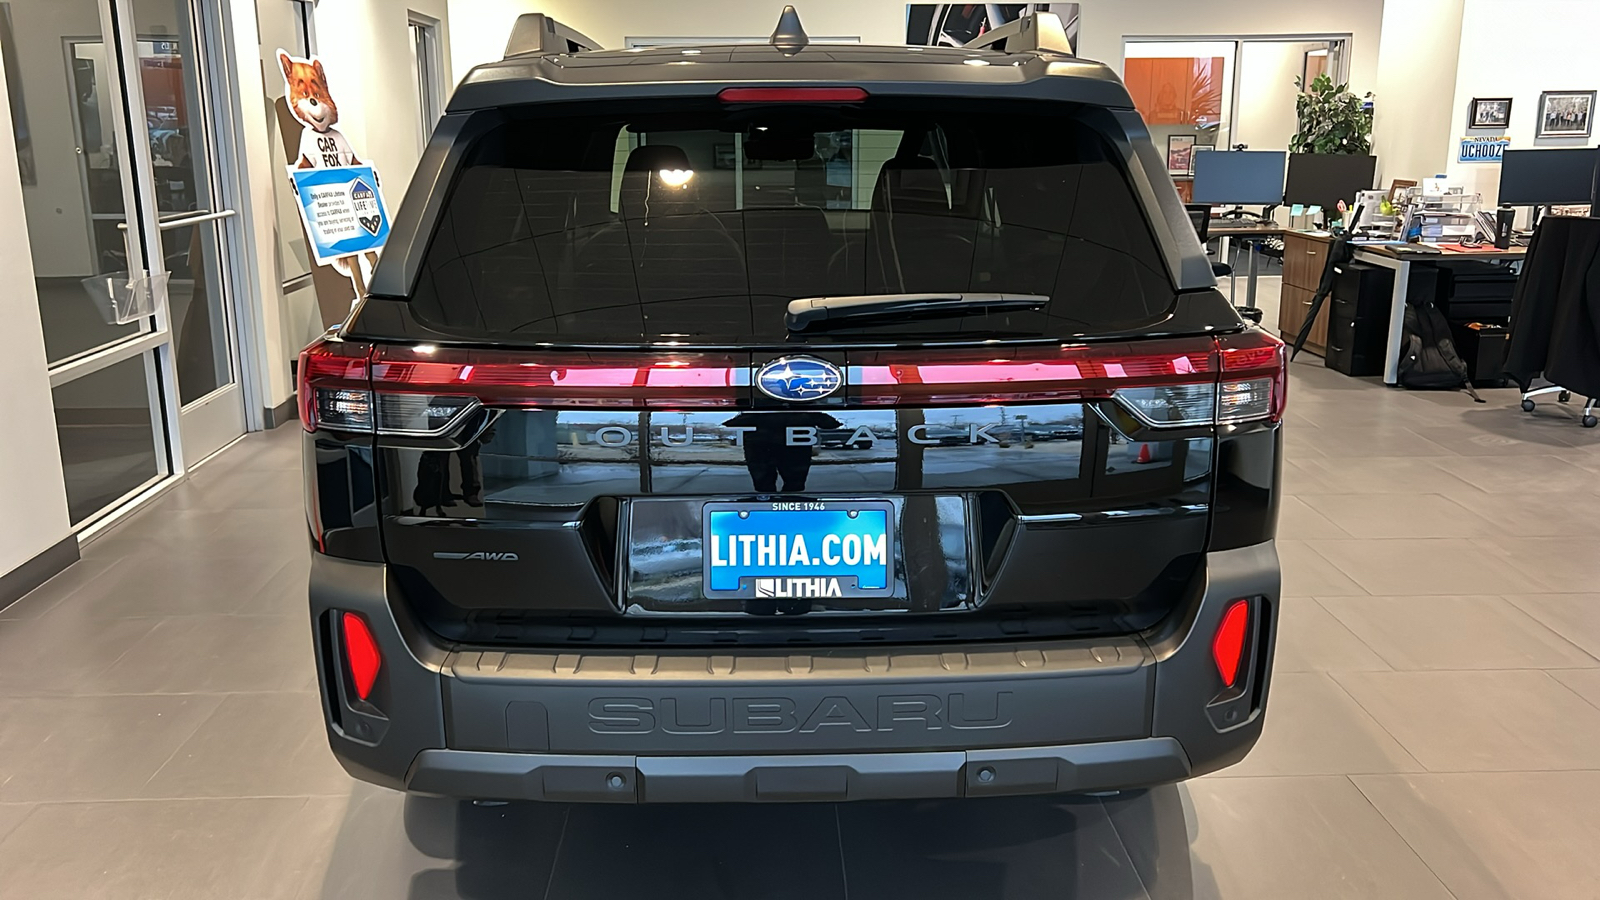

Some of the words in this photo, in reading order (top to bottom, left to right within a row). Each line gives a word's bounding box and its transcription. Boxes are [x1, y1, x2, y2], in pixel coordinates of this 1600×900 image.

[317, 137, 338, 152] CAR
[322, 153, 342, 167] FOX
[595, 423, 1000, 448] OUTBACK
[772, 502, 801, 511] SINCE
[804, 502, 825, 511] 1946
[464, 552, 519, 561] AWD
[711, 534, 887, 567] LITHIA.COM
[775, 577, 843, 598] LITHIA
[588, 691, 1013, 735] SUBARU
